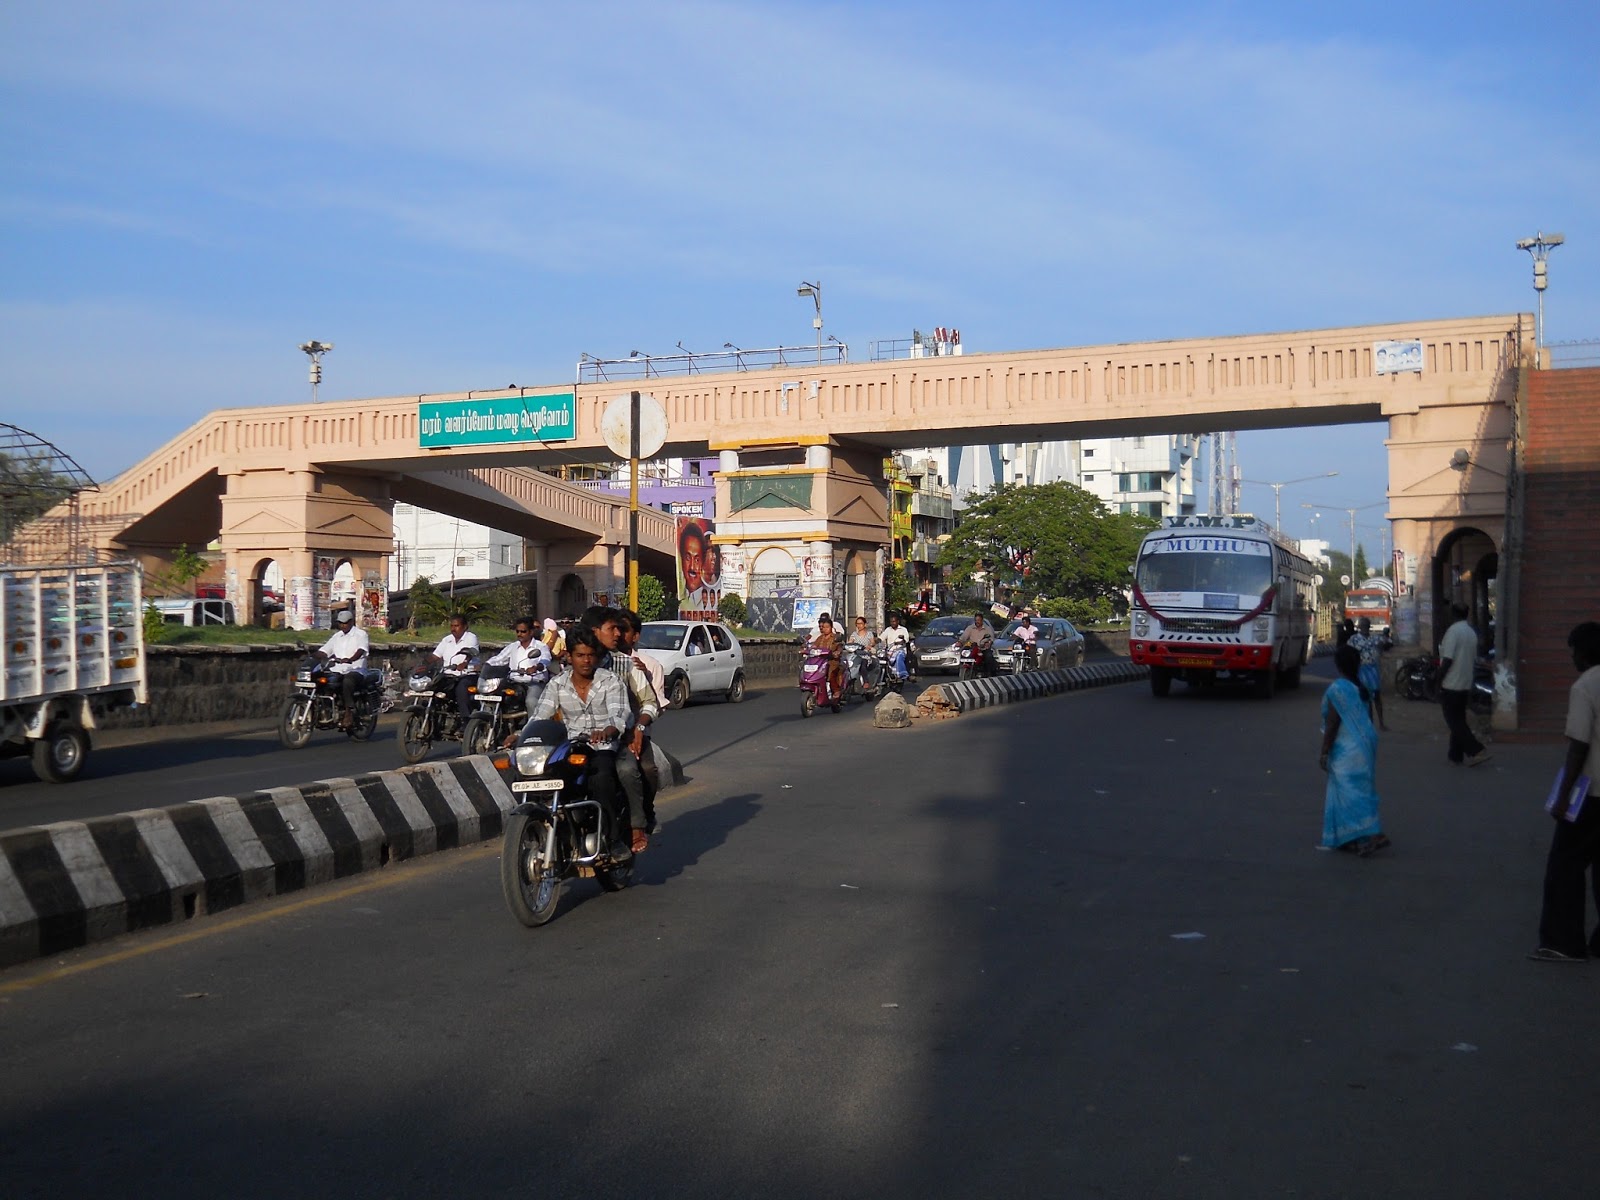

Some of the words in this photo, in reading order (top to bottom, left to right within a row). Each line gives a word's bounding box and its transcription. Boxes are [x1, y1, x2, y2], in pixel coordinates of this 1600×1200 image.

[421, 412, 442, 437] மரம்
[445, 408, 496, 435] வளர்ப்போம்
[496, 413, 519, 436] மழை
[520, 403, 570, 435] பெறுவோம்
[1167, 539, 1245, 552] MUTHU
